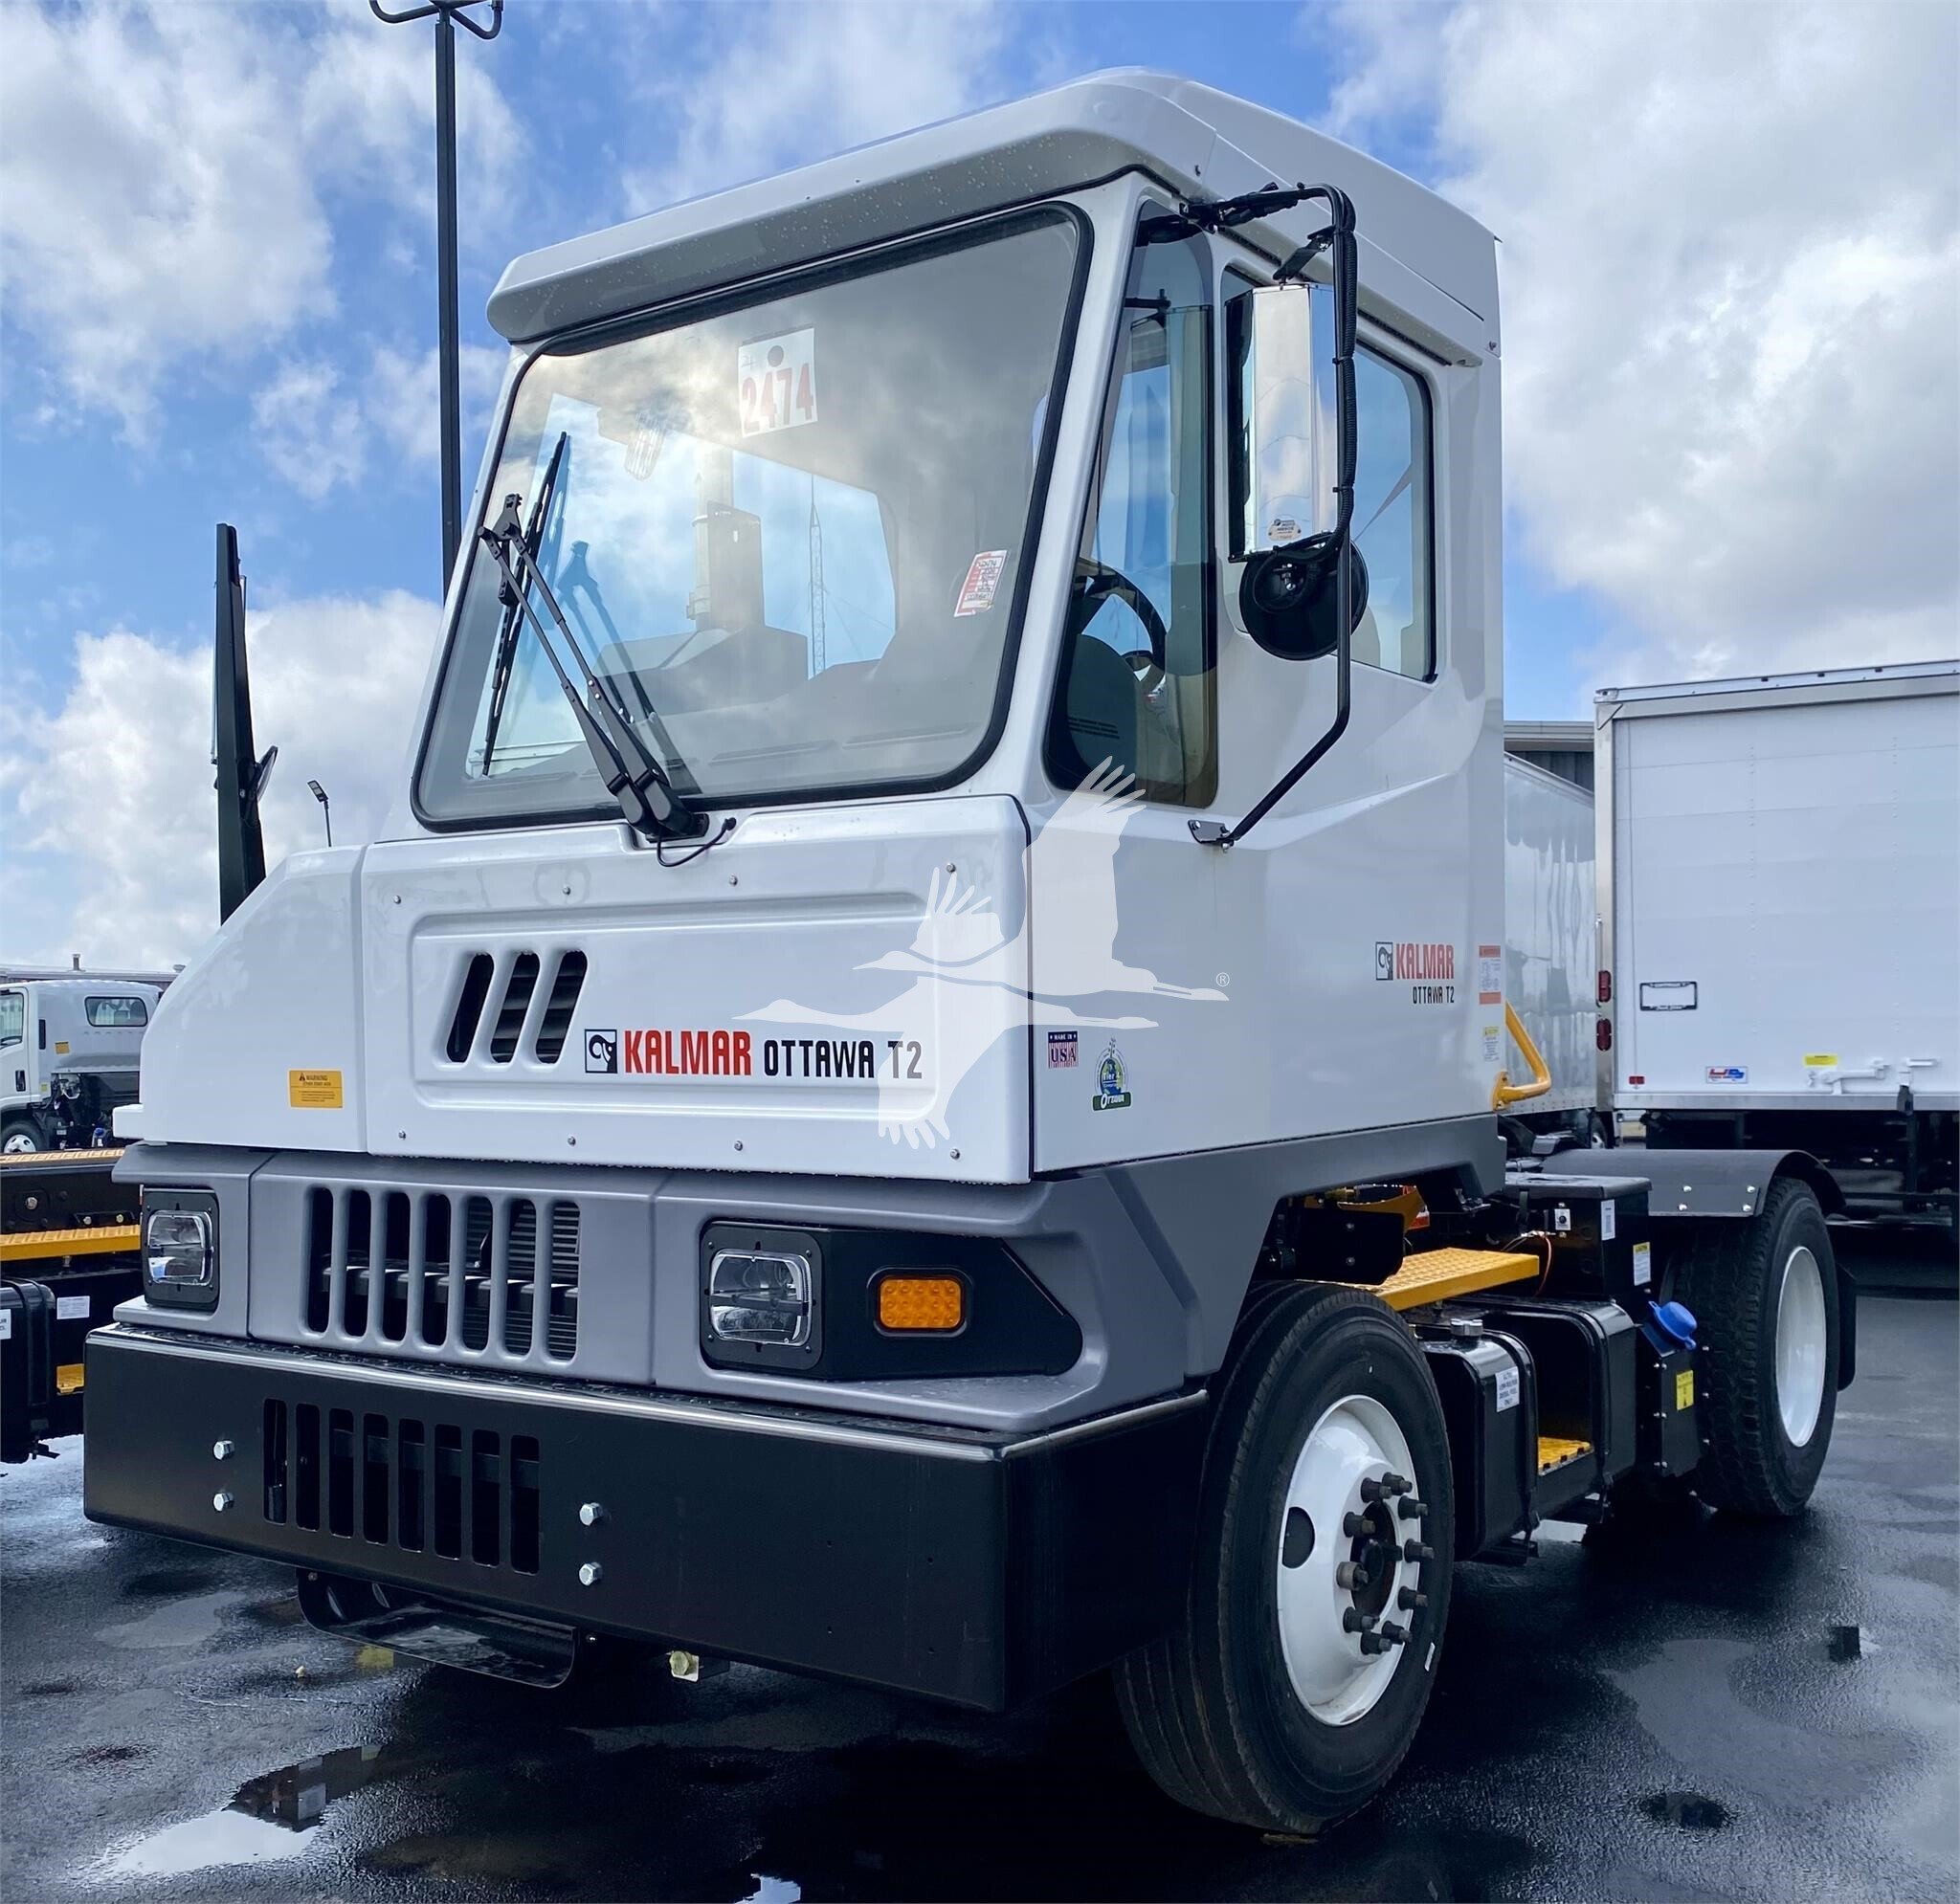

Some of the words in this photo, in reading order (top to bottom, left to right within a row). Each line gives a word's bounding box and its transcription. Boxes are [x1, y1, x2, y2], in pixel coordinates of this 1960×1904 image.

[742, 363, 814, 434] 2474
[1395, 943, 1455, 980] KALMAR
[1413, 986, 1443, 1004] OTTAWA
[1446, 986, 1455, 1004] T2
[624, 1029, 752, 1076] KALMAR
[765, 1039, 875, 1079] OTTAWA
[887, 1040, 923, 1079] T2
[1051, 1048, 1077, 1063] USA
